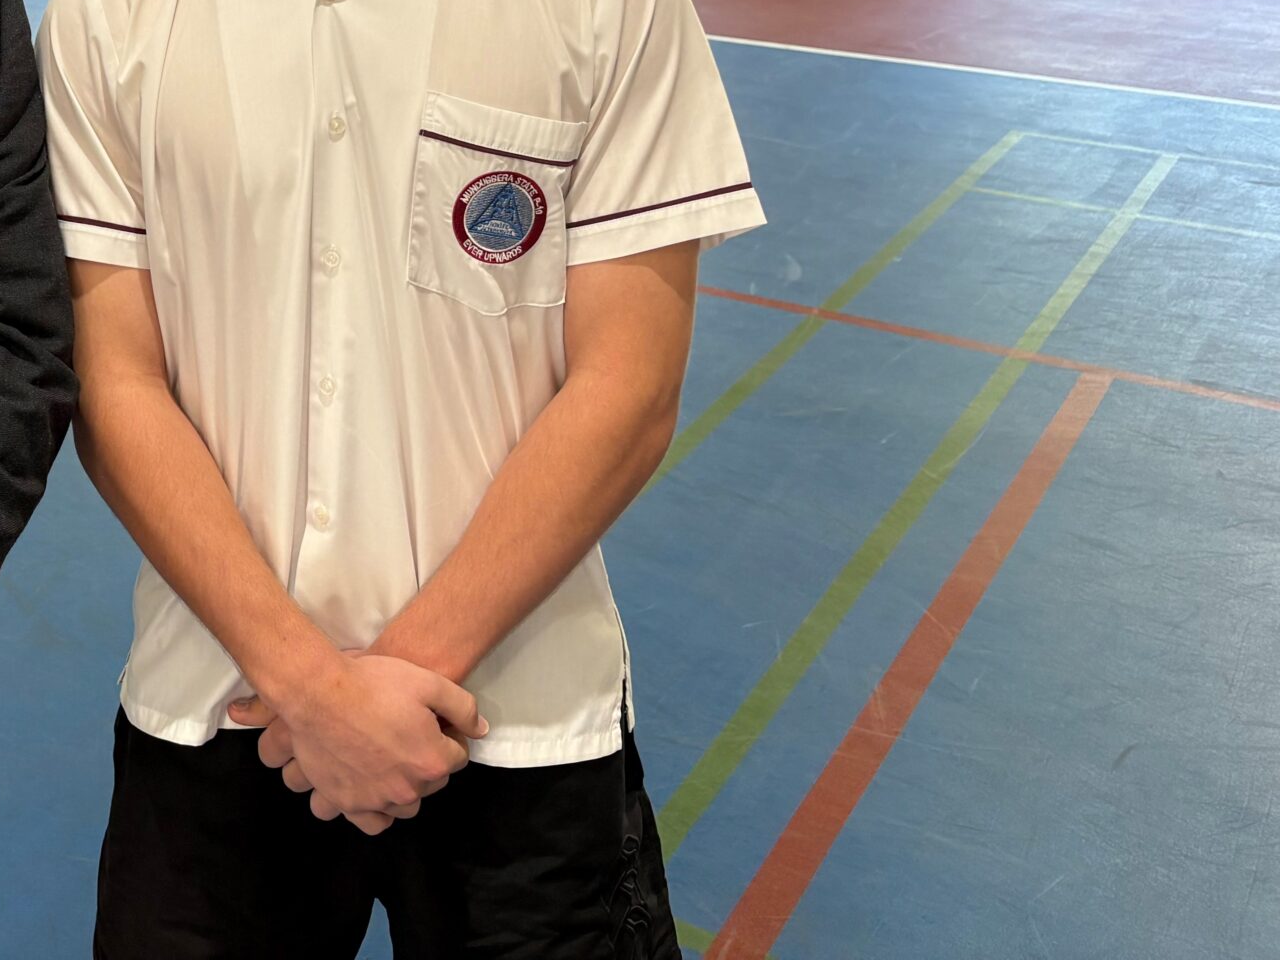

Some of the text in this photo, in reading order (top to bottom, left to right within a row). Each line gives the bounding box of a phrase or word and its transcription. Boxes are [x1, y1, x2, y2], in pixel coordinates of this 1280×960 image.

[516, 177, 538, 196] STATE
[463, 239, 522, 263] EVER UPWARDS
